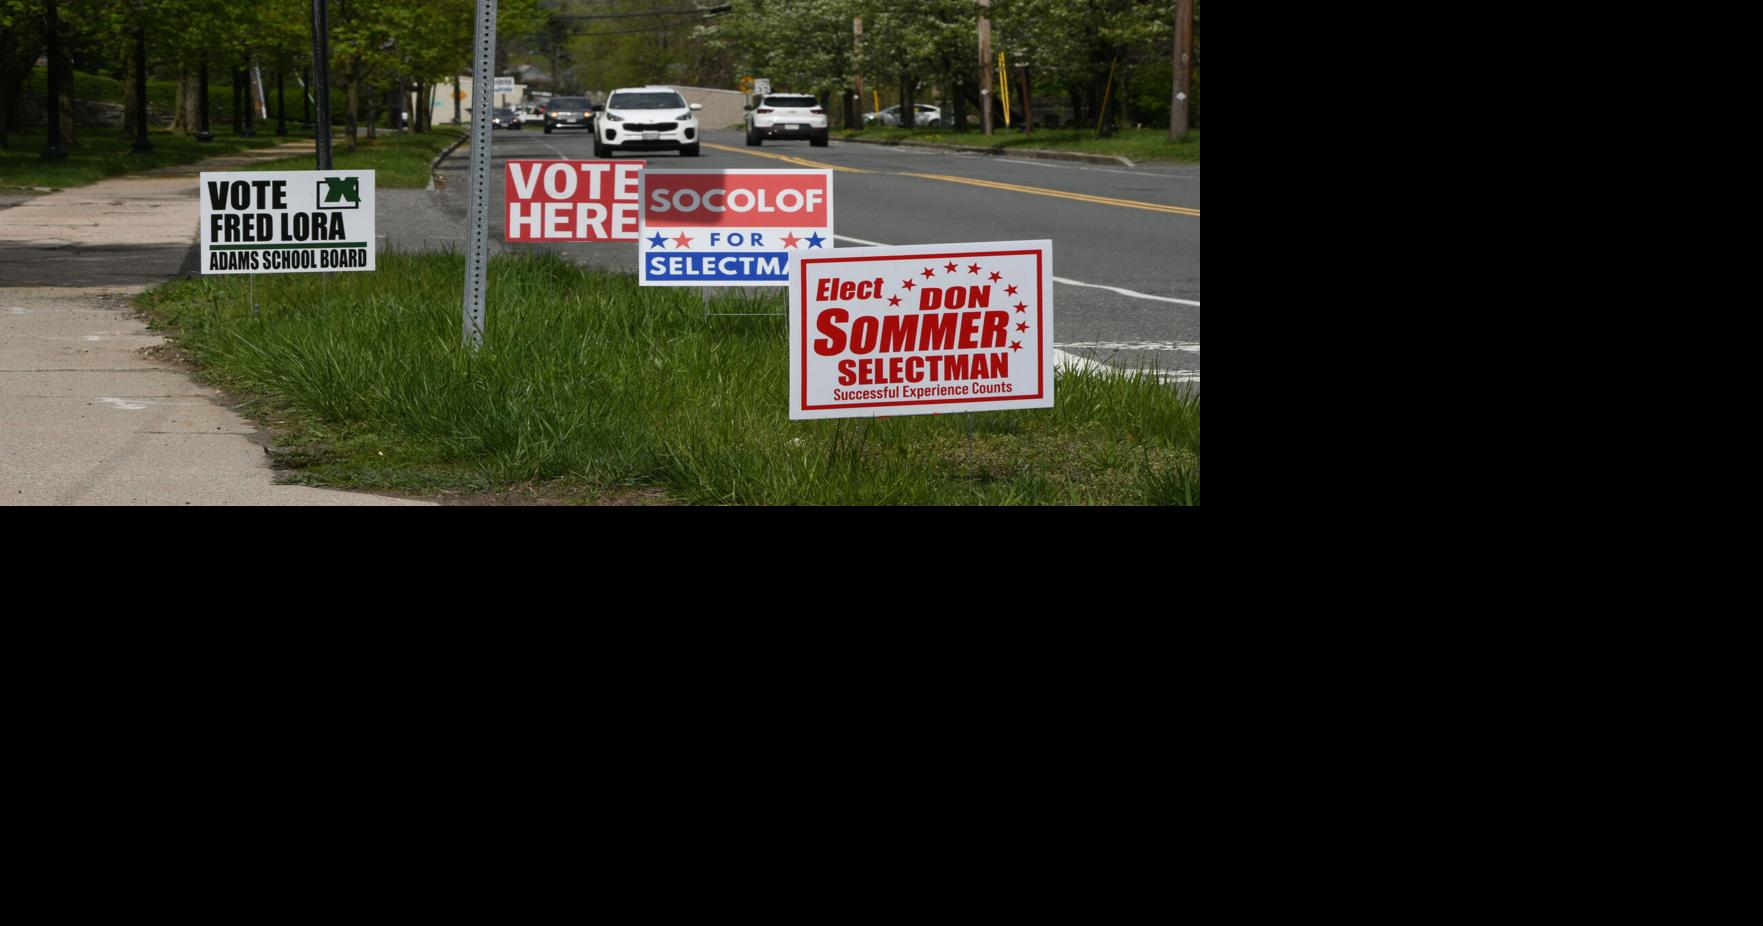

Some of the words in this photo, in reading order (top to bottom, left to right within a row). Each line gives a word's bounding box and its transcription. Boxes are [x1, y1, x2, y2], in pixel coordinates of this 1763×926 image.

[508, 162, 643, 200] VOTE
[208, 180, 288, 210] VOTE
[649, 188, 824, 213] SOCOLOF
[210, 213, 273, 242] FRED
[281, 211, 346, 242] LORA
[508, 202, 640, 239] HERE
[710, 231, 765, 247] FOR
[209, 250, 259, 271] ADAMS
[262, 249, 317, 270] SCHOOL
[320, 248, 367, 269] BOARD
[649, 256, 789, 276] SELECTM
[816, 277, 884, 302] Elect
[919, 285, 991, 311] DON
[813, 307, 1010, 357] SOMMER
[838, 352, 1009, 387] SELECTMAN
[833, 386, 900, 401] Successful
[902, 384, 969, 399] Experience
[972, 381, 1013, 395] Counts
